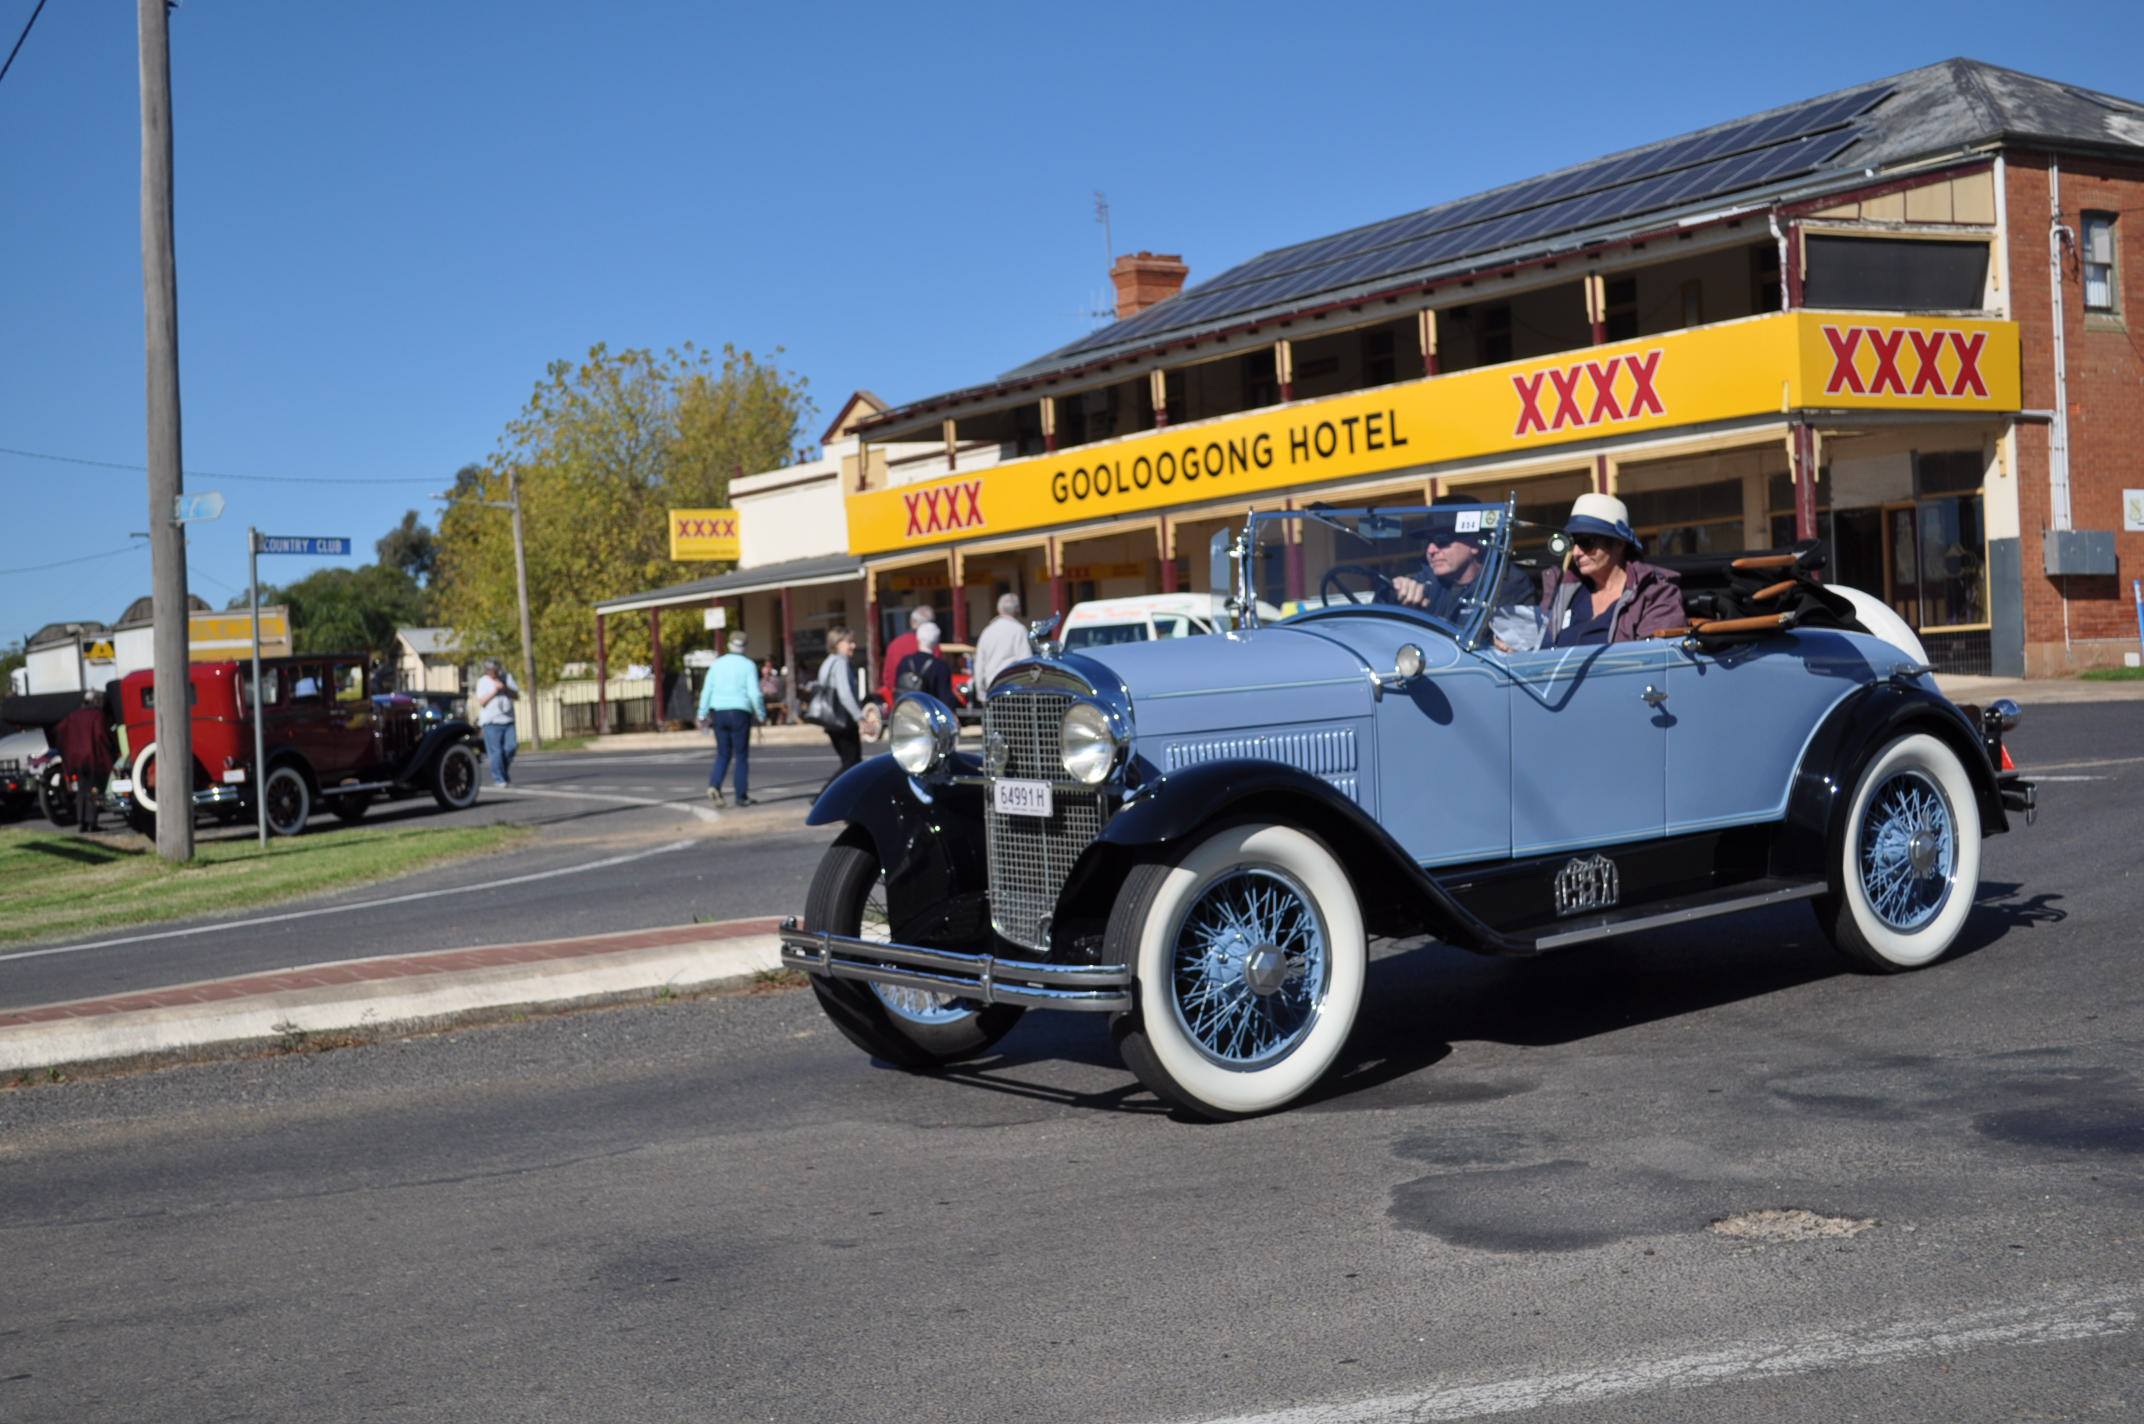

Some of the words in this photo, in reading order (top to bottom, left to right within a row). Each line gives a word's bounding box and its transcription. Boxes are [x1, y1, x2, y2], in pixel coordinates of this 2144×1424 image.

[1511, 348, 1667, 438] XXXX
[1822, 325, 1991, 399] XXXX
[1052, 433, 1273, 503] GOOLOOGONG
[1290, 410, 1408, 464] HOTEL
[676, 518, 736, 538] XXXX
[904, 479, 985, 538] XXXX
[263, 539, 309, 553] COUNTRY
[317, 540, 343, 554] CLUB
